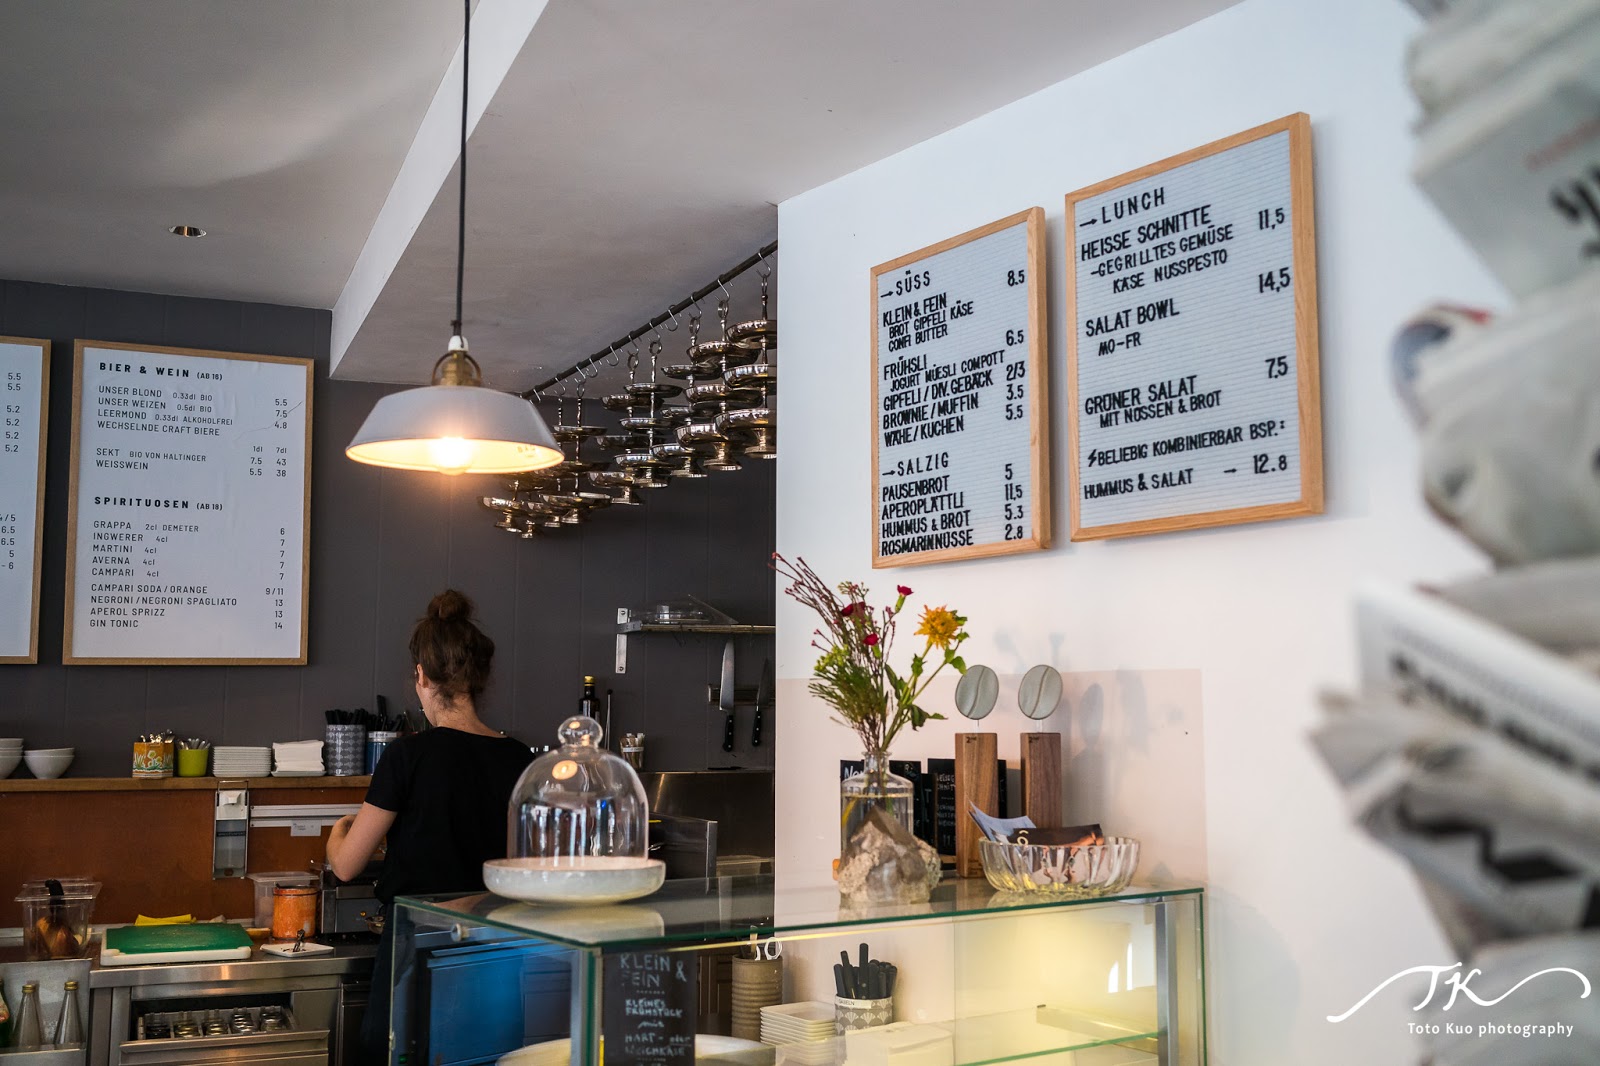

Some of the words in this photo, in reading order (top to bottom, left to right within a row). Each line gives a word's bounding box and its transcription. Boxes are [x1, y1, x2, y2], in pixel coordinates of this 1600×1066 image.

[1102, 187, 1164, 224] LUNCH
[1082, 230, 1131, 261] HEISSE
[1138, 204, 1211, 243] SCHNITTE
[1180, 224, 1233, 252] GEMÜSE
[1154, 249, 1227, 282] NUSSPESTO
[896, 270, 930, 296] SÜSS
[883, 305, 912, 327] KLEIN
[923, 292, 947, 314] FEIN
[1008, 270, 1025, 286] 8.5
[889, 324, 909, 339] BROT
[914, 310, 946, 331] GIPFELI
[951, 300, 974, 320] KÄSE
[1086, 309, 1132, 337] SALAT
[1137, 298, 1180, 324] BOWL
[888, 336, 911, 352] CONFI
[916, 324, 948, 345] BUTTER
[1098, 332, 1141, 356] MO-FR
[884, 354, 927, 380] FRÜHSLI
[1006, 330, 1024, 346] 6.5
[8, 372, 21, 380] 5.5
[100, 362, 130, 372] BIER
[156, 367, 189, 377] WEIN
[890, 374, 920, 392] JOGURT
[961, 350, 1005, 374] COMPOTT
[884, 388, 920, 411] GIPFELI
[1006, 361, 1025, 381] 2/3
[1148, 375, 1197, 401] SALAT
[1265, 356, 1288, 378] 7.5
[8, 383, 21, 391] 5.5
[99, 386, 129, 395] UNSER
[132, 388, 162, 398] BLOND
[1006, 384, 1024, 400] 3.5
[6, 405, 20, 413] 5.2
[98, 398, 128, 406] UNSER
[132, 400, 166, 409] WEIZEN
[1100, 411, 1120, 428] MIT
[1179, 399, 1187, 413] &
[1190, 390, 1222, 411] BROT
[98, 409, 147, 419] LEERMOND
[183, 416, 233, 425] ALKOHOLFREI
[1006, 404, 1023, 420] 5.5
[6, 418, 20, 426] 5.2
[97, 421, 159, 432] WECHSELNDE
[162, 425, 191, 434] CRAFT
[194, 427, 220, 436] BIERE
[6, 432, 19, 440] 5.2
[5, 444, 18, 453] 5.2
[1098, 444, 1147, 466] BELIEBIG
[1153, 427, 1243, 456] KOMBINIERBAR
[96, 448, 119, 456] SEKT
[164, 453, 206, 462] HALTINGER
[96, 460, 148, 470] WEISSWEIN
[898, 452, 948, 476] SALZIG
[882, 475, 950, 502] PAUSENBROT
[1005, 463, 1012, 480] 5
[1084, 479, 1133, 499] HUMMUS
[1138, 473, 1148, 490] &
[1152, 468, 1193, 489] SALAT
[1253, 454, 1287, 474] 12.8
[94, 496, 189, 509] SPIRITUOSEN
[93, 521, 132, 530] GRAPPA
[882, 517, 927, 538] HUMMUS
[931, 518, 938, 531] &
[941, 510, 971, 529] BROT
[1005, 504, 1023, 520] 5.3
[93, 533, 144, 542] INGWERER
[1005, 524, 1023, 540] 2.8
[93, 544, 132, 553] MARTINI
[8, 562, 14, 570] 6
[92, 556, 130, 565] AVERNA
[92, 568, 134, 576] CAMPARI
[91, 584, 134, 592] CAMPARI
[187, 597, 237, 606] SPAGLIATO
[90, 608, 128, 616] APEROL
[620, 953, 670, 972] KLEIN
